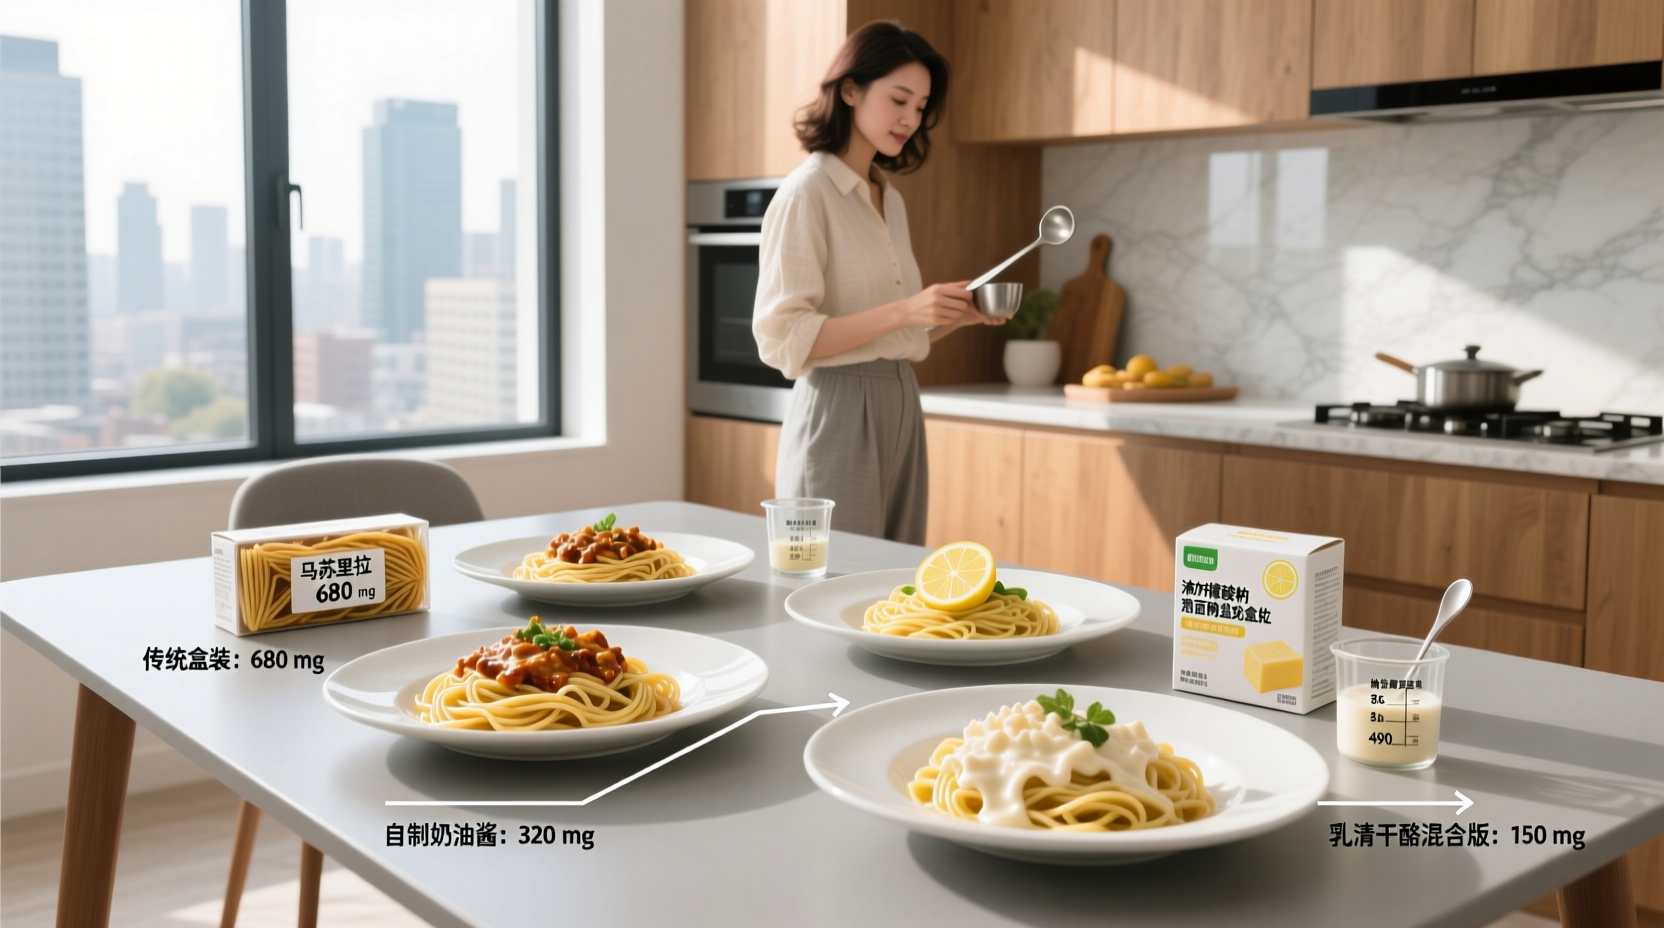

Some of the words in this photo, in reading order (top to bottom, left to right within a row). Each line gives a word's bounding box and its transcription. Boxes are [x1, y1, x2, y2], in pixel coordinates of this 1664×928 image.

[301, 554, 373, 581] 马苏里拉
[316, 581, 353, 603] 680
[358, 586, 376, 600] mg
[1369, 731, 1393, 746] 490
